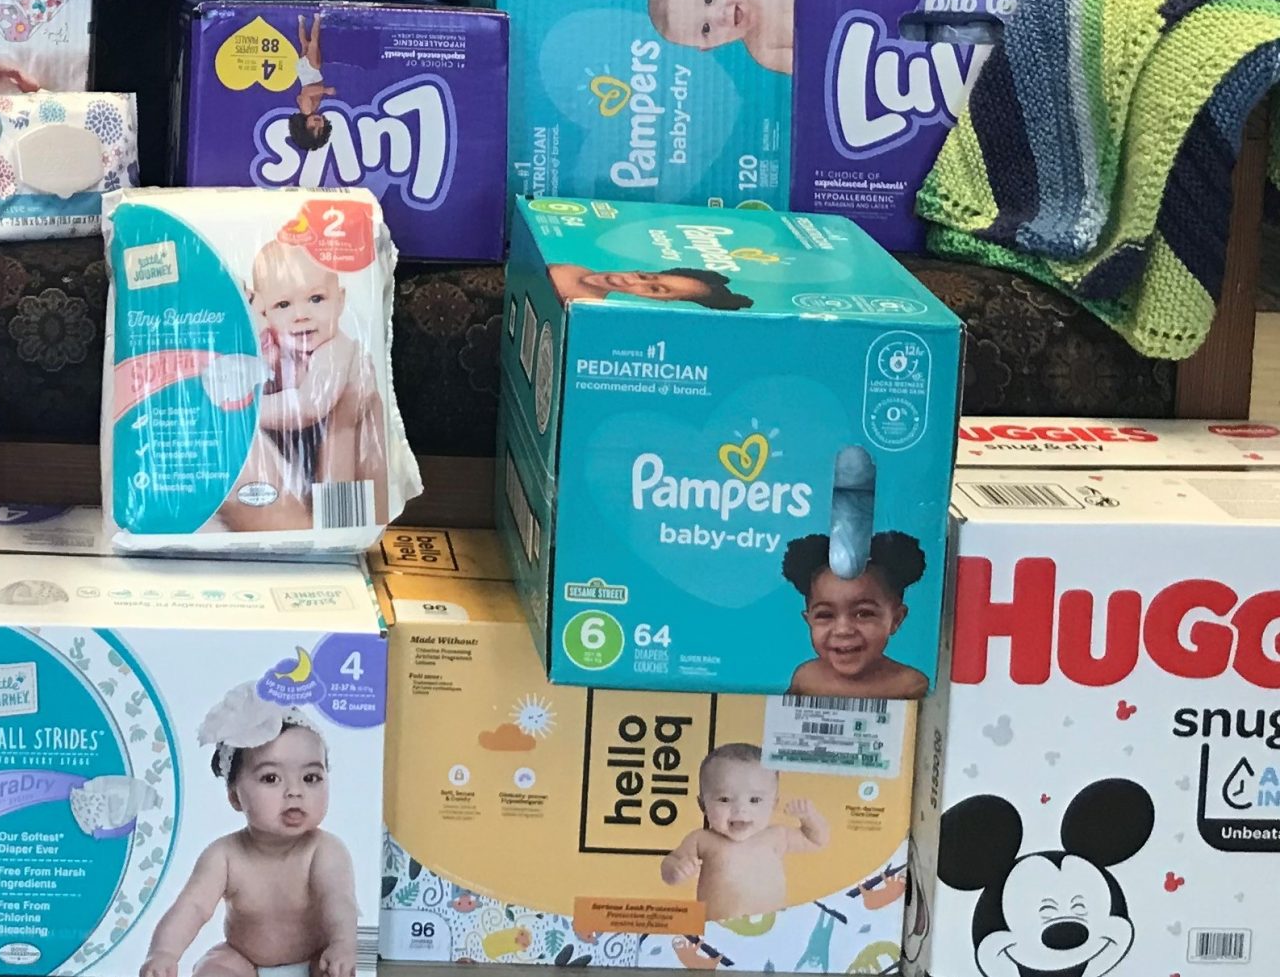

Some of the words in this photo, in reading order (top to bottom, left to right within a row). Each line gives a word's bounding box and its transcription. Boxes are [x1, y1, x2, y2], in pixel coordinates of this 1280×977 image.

[261, 38, 279, 53] 88
[393, 39, 466, 48] HYPOALLERGENIC
[261, 60, 276, 80] 4
[421, 60, 453, 69] CHOICE
[610, 39, 665, 187] Pampers
[669, 64, 691, 164] baby-dry
[261, 85, 446, 200] Luvs
[739, 155, 758, 191] 120
[828, 170, 863, 179] CHOICE
[814, 179, 867, 188] experienced
[814, 192, 894, 203] HYPOALLERGENIC
[322, 206, 346, 238] 2
[676, 224, 741, 272] Pampers
[133, 265, 173, 282] JOURNEY
[163, 307, 225, 326] Bundles
[647, 340, 666, 362] #1
[577, 359, 708, 381] PEDIATRICIAN
[576, 380, 656, 393] recommended
[985, 443, 1042, 452] snug
[1064, 442, 1104, 453] dry
[631, 452, 813, 521] Pampers
[660, 522, 781, 553] baby-dry
[393, 535, 418, 561] hello
[569, 587, 596, 599] SESAME
[597, 588, 624, 600] STREET
[410, 635, 435, 645] Made
[438, 636, 479, 646] Without:
[580, 617, 606, 649] 6
[634, 623, 672, 648] 64
[634, 649, 669, 662] DIAPERS
[340, 651, 364, 681] 4
[634, 662, 669, 675] COUCHES
[332, 699, 347, 710] 82
[604, 714, 646, 825] hello
[649, 715, 692, 826] bello
[36, 845, 59, 854] Ever
[24, 866, 51, 876] From
[54, 867, 86, 877] Harsh
[23, 901, 50, 910] From
[411, 921, 435, 939] 96
